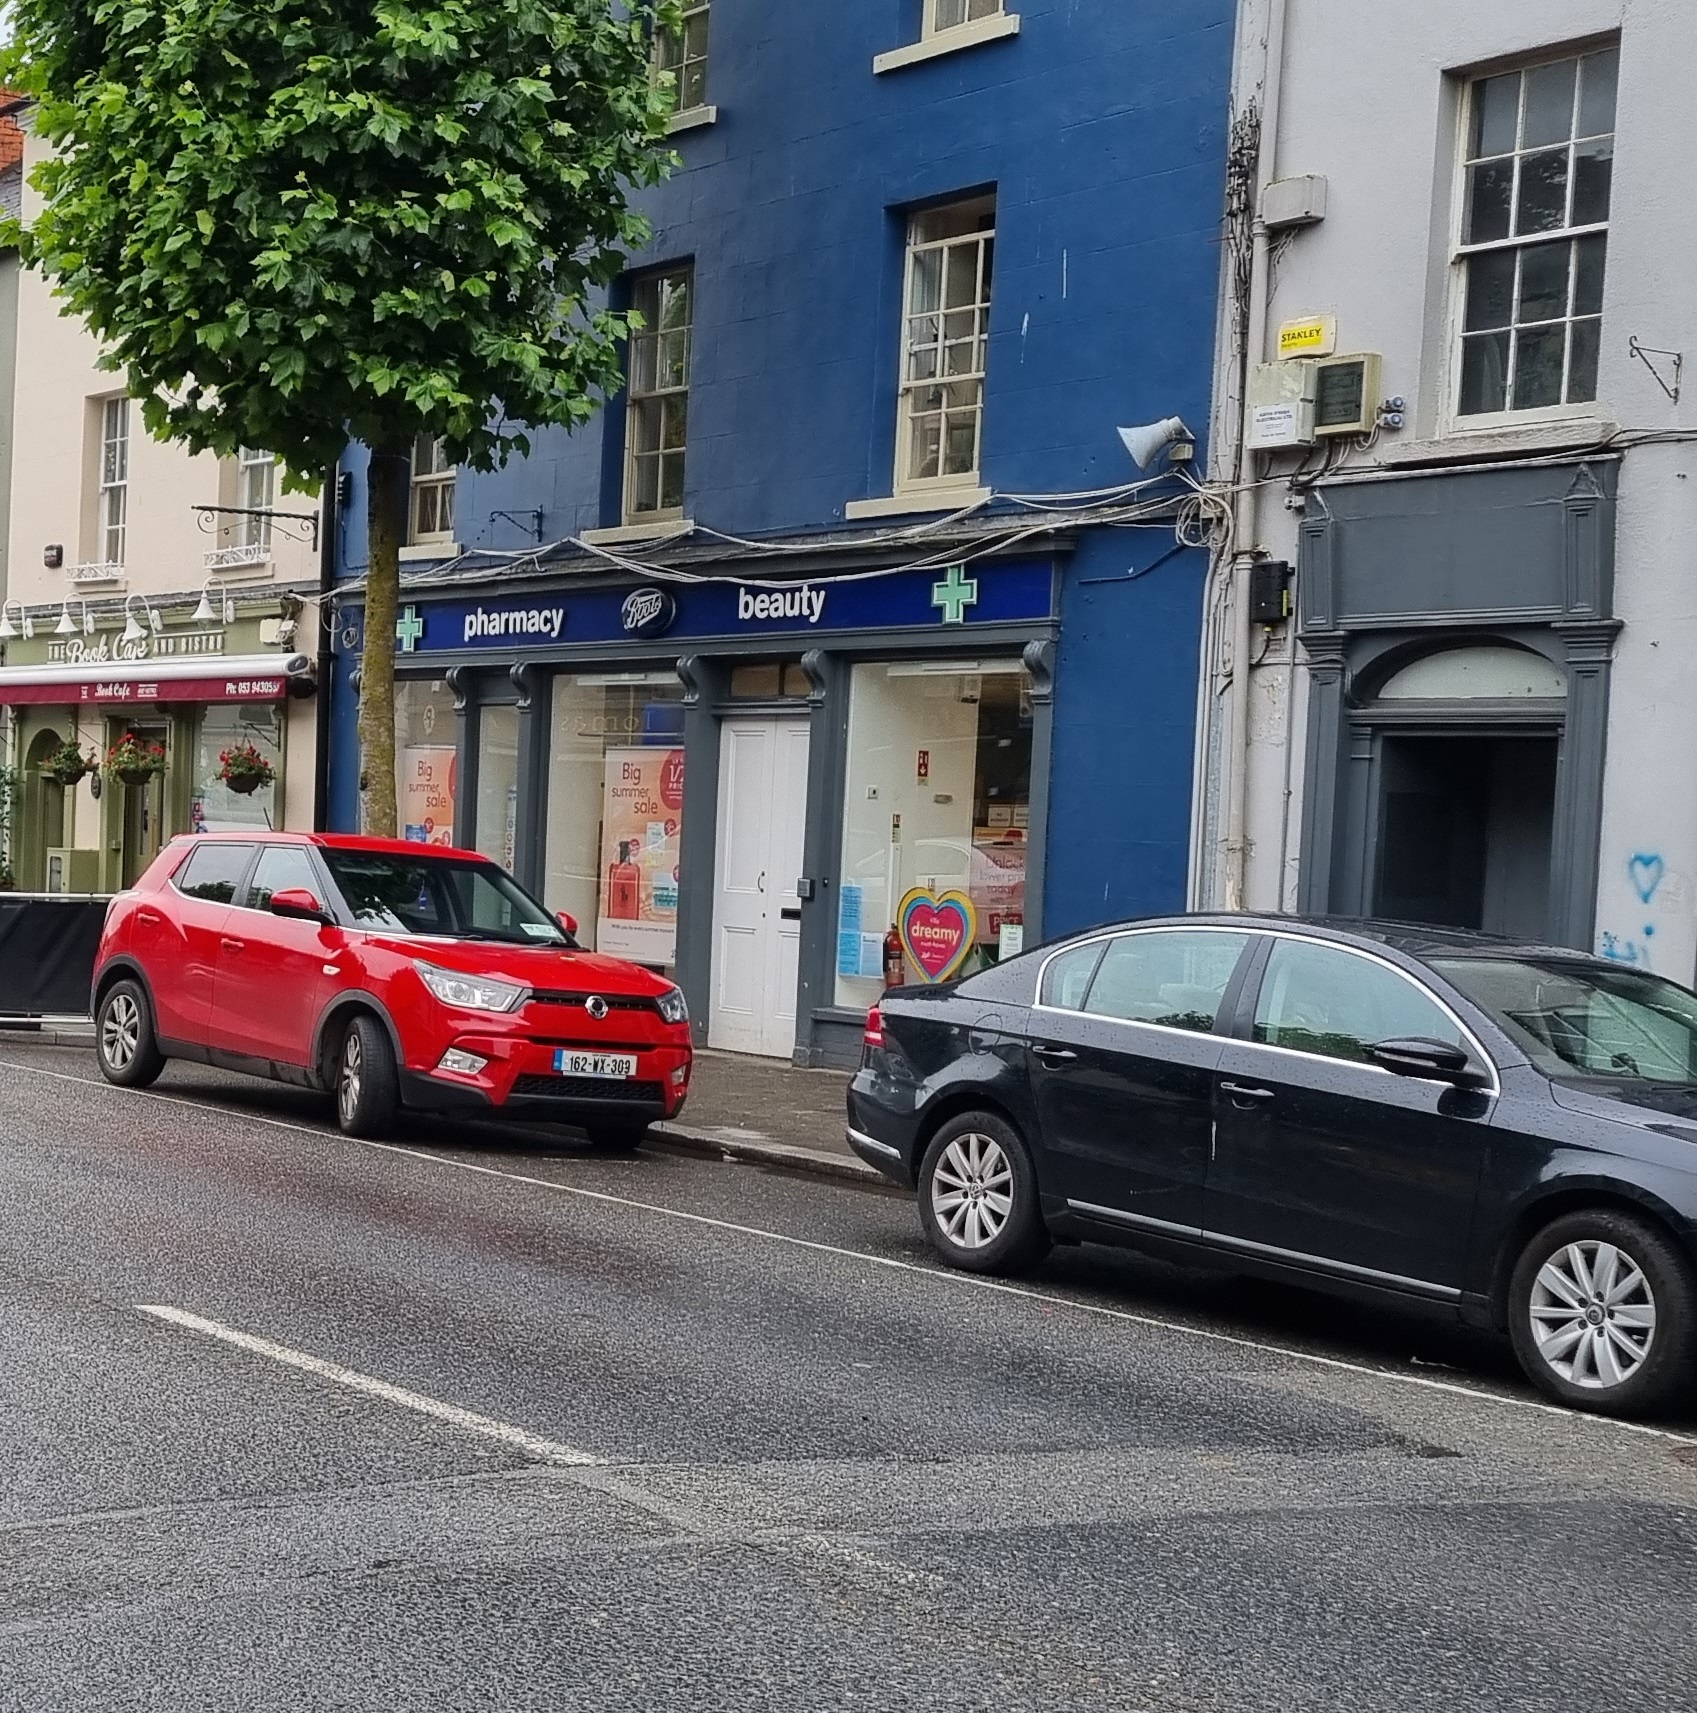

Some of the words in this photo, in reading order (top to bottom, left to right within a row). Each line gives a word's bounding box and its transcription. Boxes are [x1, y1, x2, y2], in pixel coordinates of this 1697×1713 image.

[1281, 327, 1322, 343] STANLEY
[624, 593, 662, 630] Boots
[738, 584, 826, 623] beauty
[464, 607, 564, 642] pharmacy
[66, 634, 110, 664] Book
[153, 638, 175, 653] AND
[181, 635, 223, 652] BISTRO
[417, 760, 433, 782] Big
[622, 762, 642, 786] Big
[408, 783, 440, 793] summer
[611, 787, 649, 798] summer
[425, 792, 447, 808] sale
[633, 797, 659, 815] sale
[987, 884, 1016, 899] today
[911, 921, 960, 946] dreamy
[570, 1056, 631, 1074] 162-WX-309
